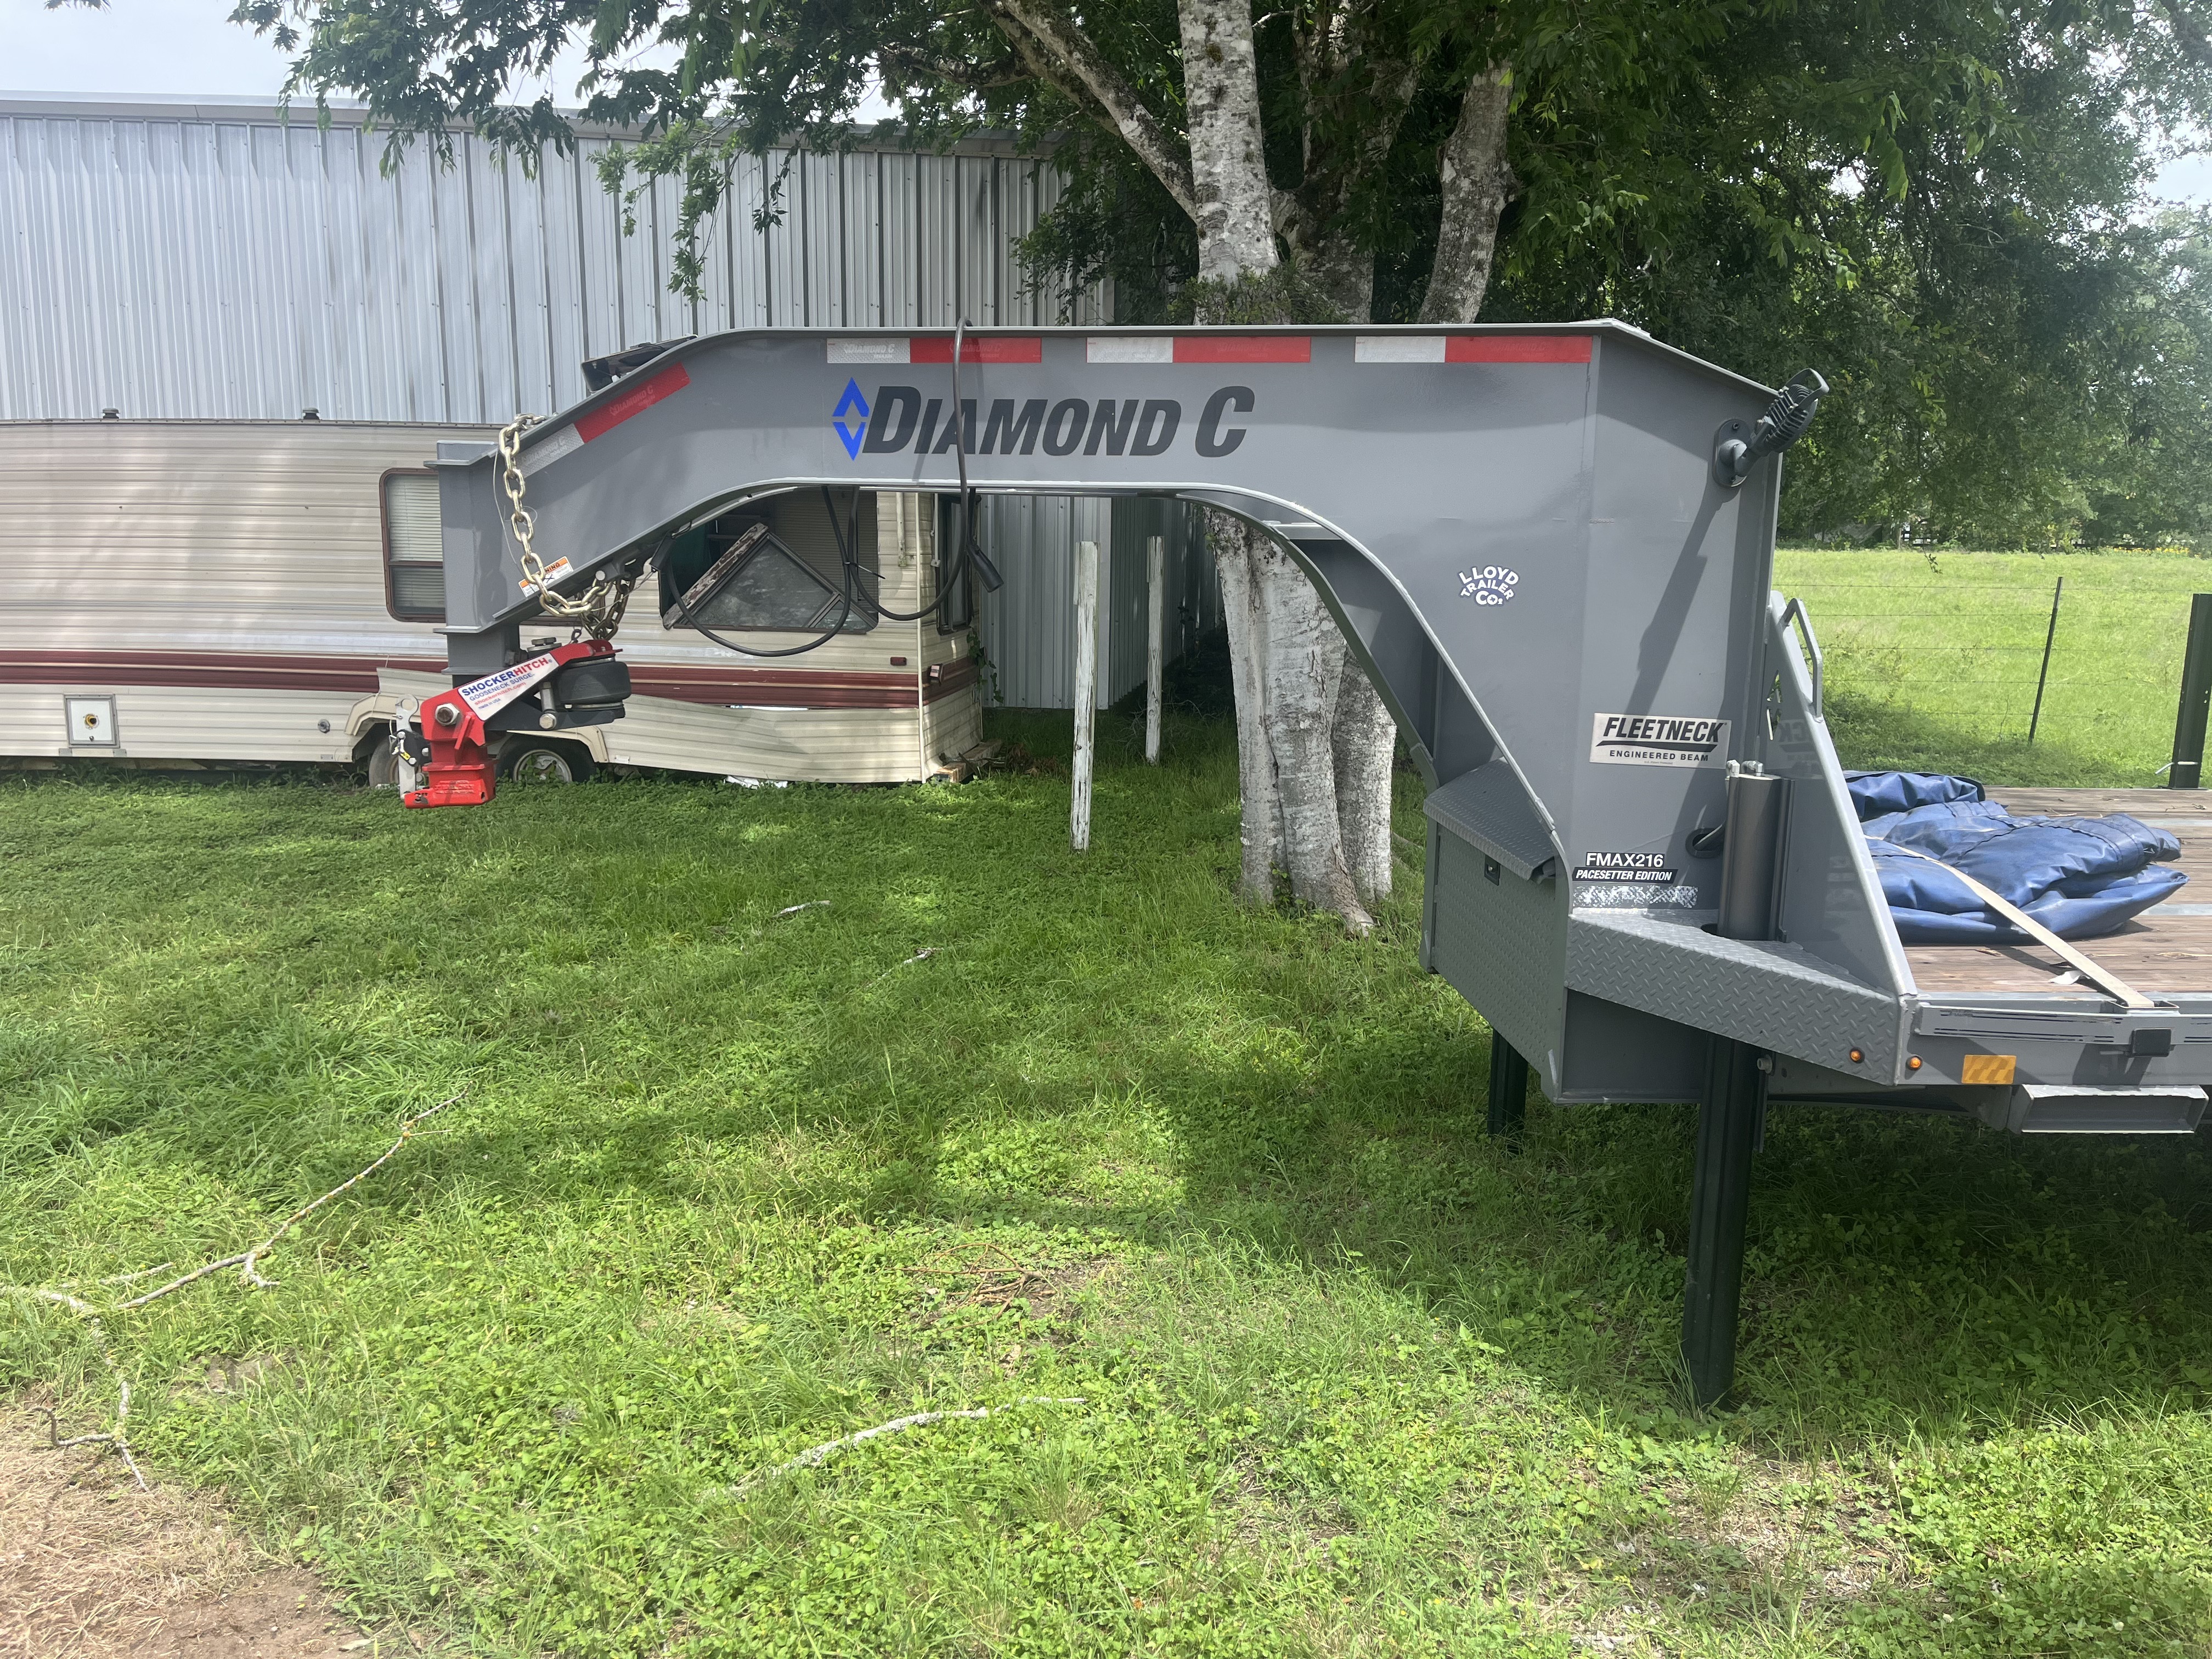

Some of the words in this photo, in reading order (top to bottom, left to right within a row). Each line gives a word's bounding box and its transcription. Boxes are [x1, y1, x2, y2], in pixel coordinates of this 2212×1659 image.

[862, 386, 1181, 456] DIAMOND
[1195, 386, 1255, 458] C
[1459, 566, 1519, 585] LLOYD
[1460, 579, 1514, 600] TRAILER
[462, 657, 549, 696] SHOCKERHITCH
[469, 682, 510, 701] GOOSENECK
[511, 673, 533, 685] SURGE
[475, 682, 527, 706] shockerhitch.com
[1603, 717, 1724, 742] FLEETNECK
[1610, 750, 1675, 760] ENGINEERED
[1586, 853, 1663, 867] FMAX216
[1576, 870, 1634, 881] PACESETTER
[1635, 871, 1672, 881] EDITION
